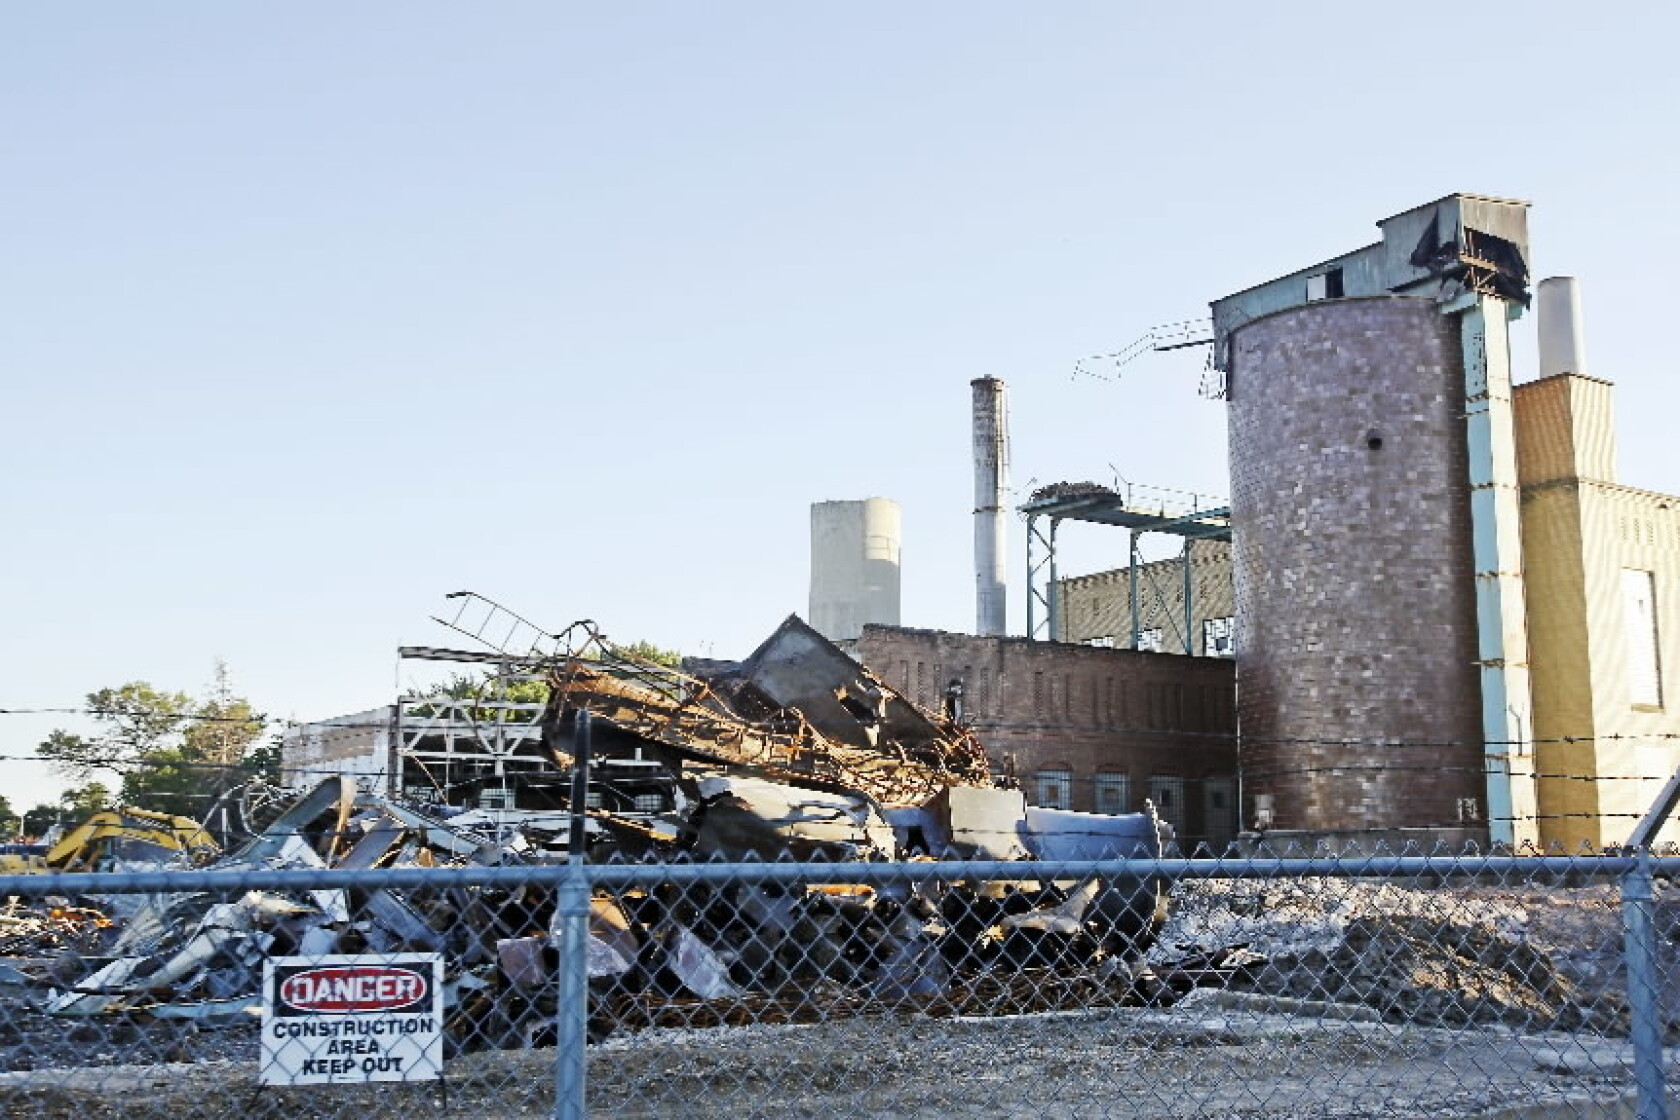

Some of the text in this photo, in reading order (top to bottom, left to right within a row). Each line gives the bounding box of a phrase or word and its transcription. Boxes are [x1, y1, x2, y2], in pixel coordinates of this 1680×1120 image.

[291, 975, 416, 1003] DANGER
[273, 1018, 433, 1039] CONSTRUCTION
[327, 1039, 379, 1055] AREA
[303, 1057, 404, 1076] KEEP OUT
